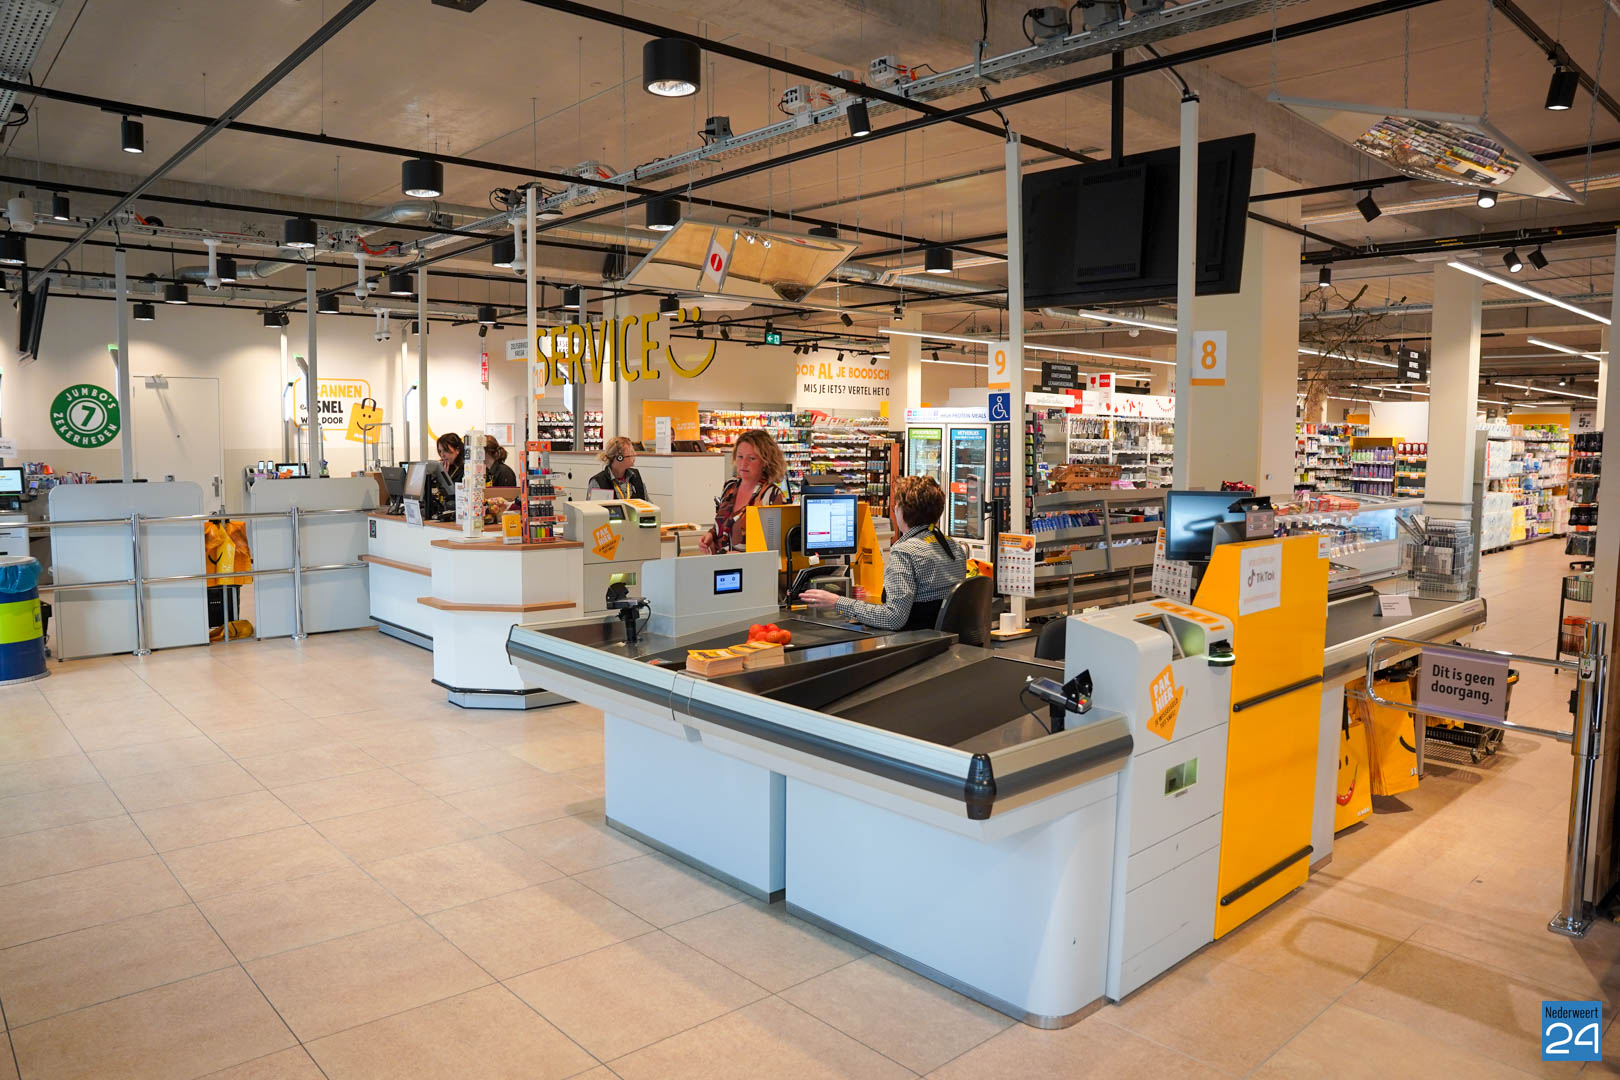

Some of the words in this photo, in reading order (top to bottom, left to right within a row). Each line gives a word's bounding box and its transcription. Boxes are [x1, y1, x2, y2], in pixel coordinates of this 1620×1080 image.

[536, 312, 660, 387] SERVICE
[1201, 340, 1217, 370] 8
[817, 362, 833, 380] AL
[836, 366, 847, 378] JE
[995, 350, 1006, 375] 9
[535, 368, 544, 388] 10
[804, 384, 817, 393] MIS
[819, 384, 826, 394] JE
[827, 385, 846, 394] IETS?
[848, 386, 871, 396] VERTEL
[873, 387, 885, 396] HET
[66, 387, 117, 409] JUMBO'S
[317, 384, 362, 398] ANNEN
[81, 404, 97, 427] 7
[53, 412, 118, 445] ZEKERHEDEN
[1153, 672, 1171, 700] PAK
[1432, 664, 1450, 679] Dit
[1452, 668, 1463, 681] is
[1464, 673, 1495, 686] geen
[1155, 686, 1174, 714] HIER
[1431, 680, 1494, 705] doorgang.
